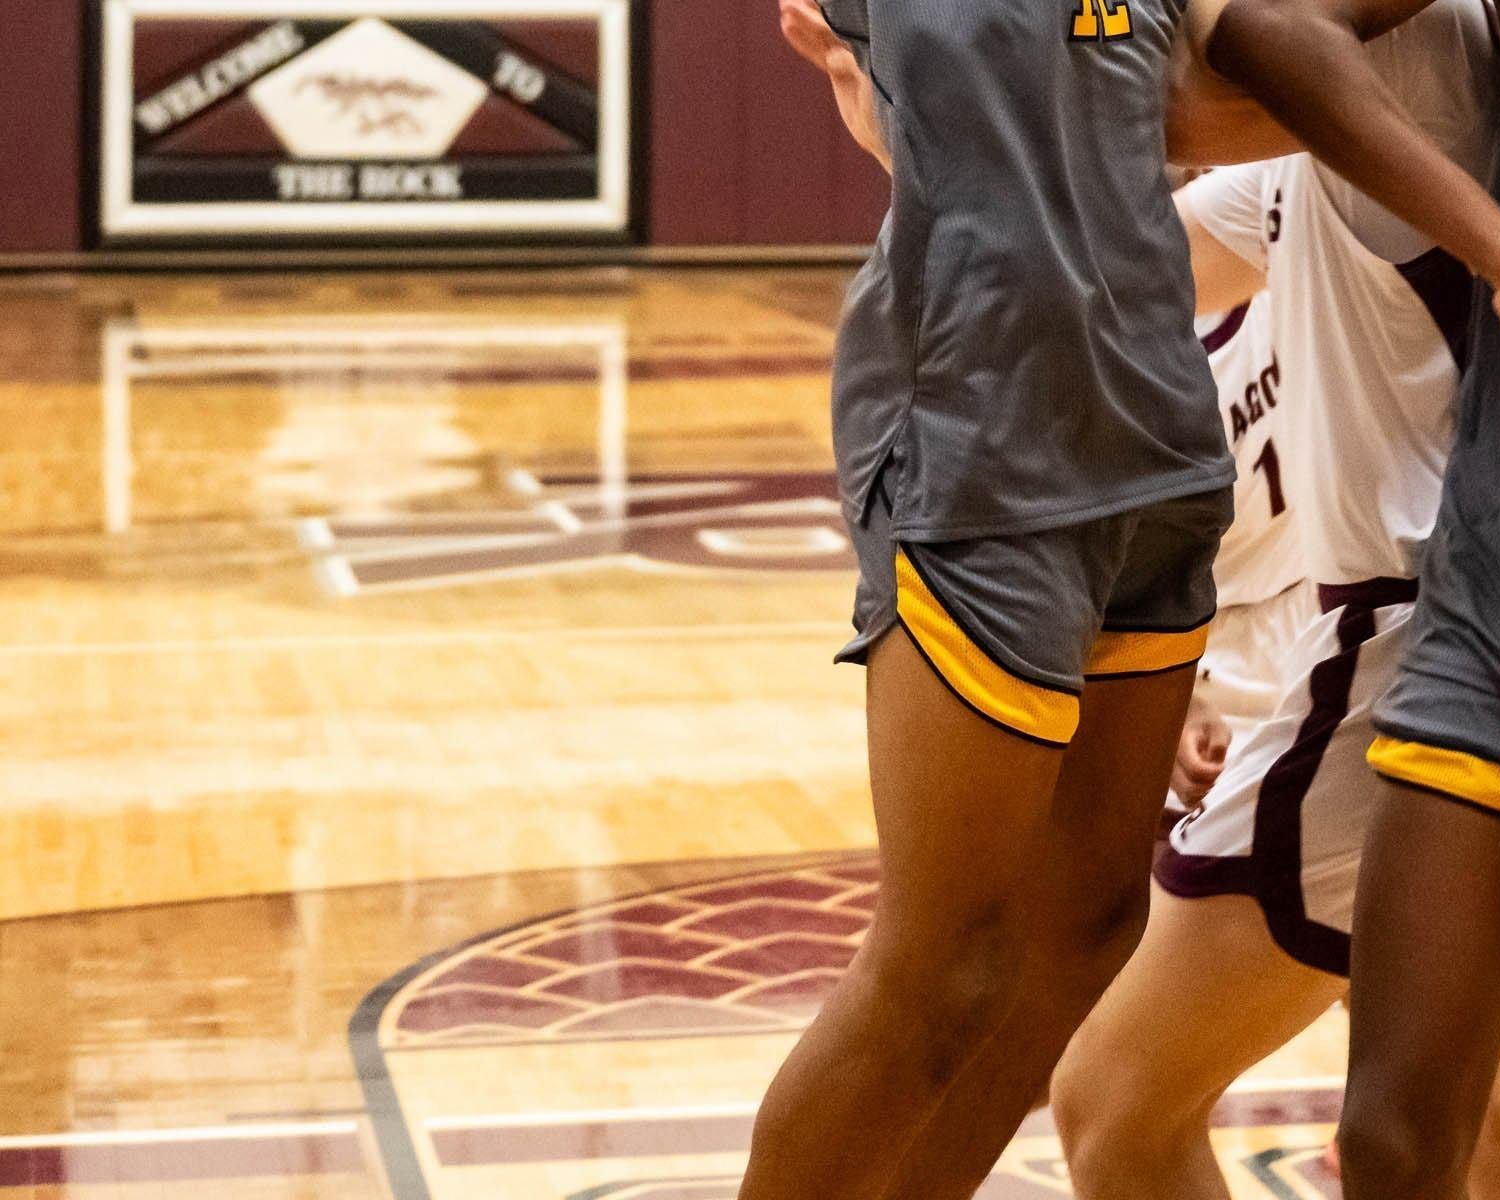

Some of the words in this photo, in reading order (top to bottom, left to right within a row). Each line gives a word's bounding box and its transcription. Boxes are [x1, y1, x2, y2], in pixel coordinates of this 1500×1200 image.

[493, 51, 546, 103] TO
[274, 164, 353, 199] THE
[359, 164, 463, 199] ROCK
[1252, 435, 1287, 519] 1
